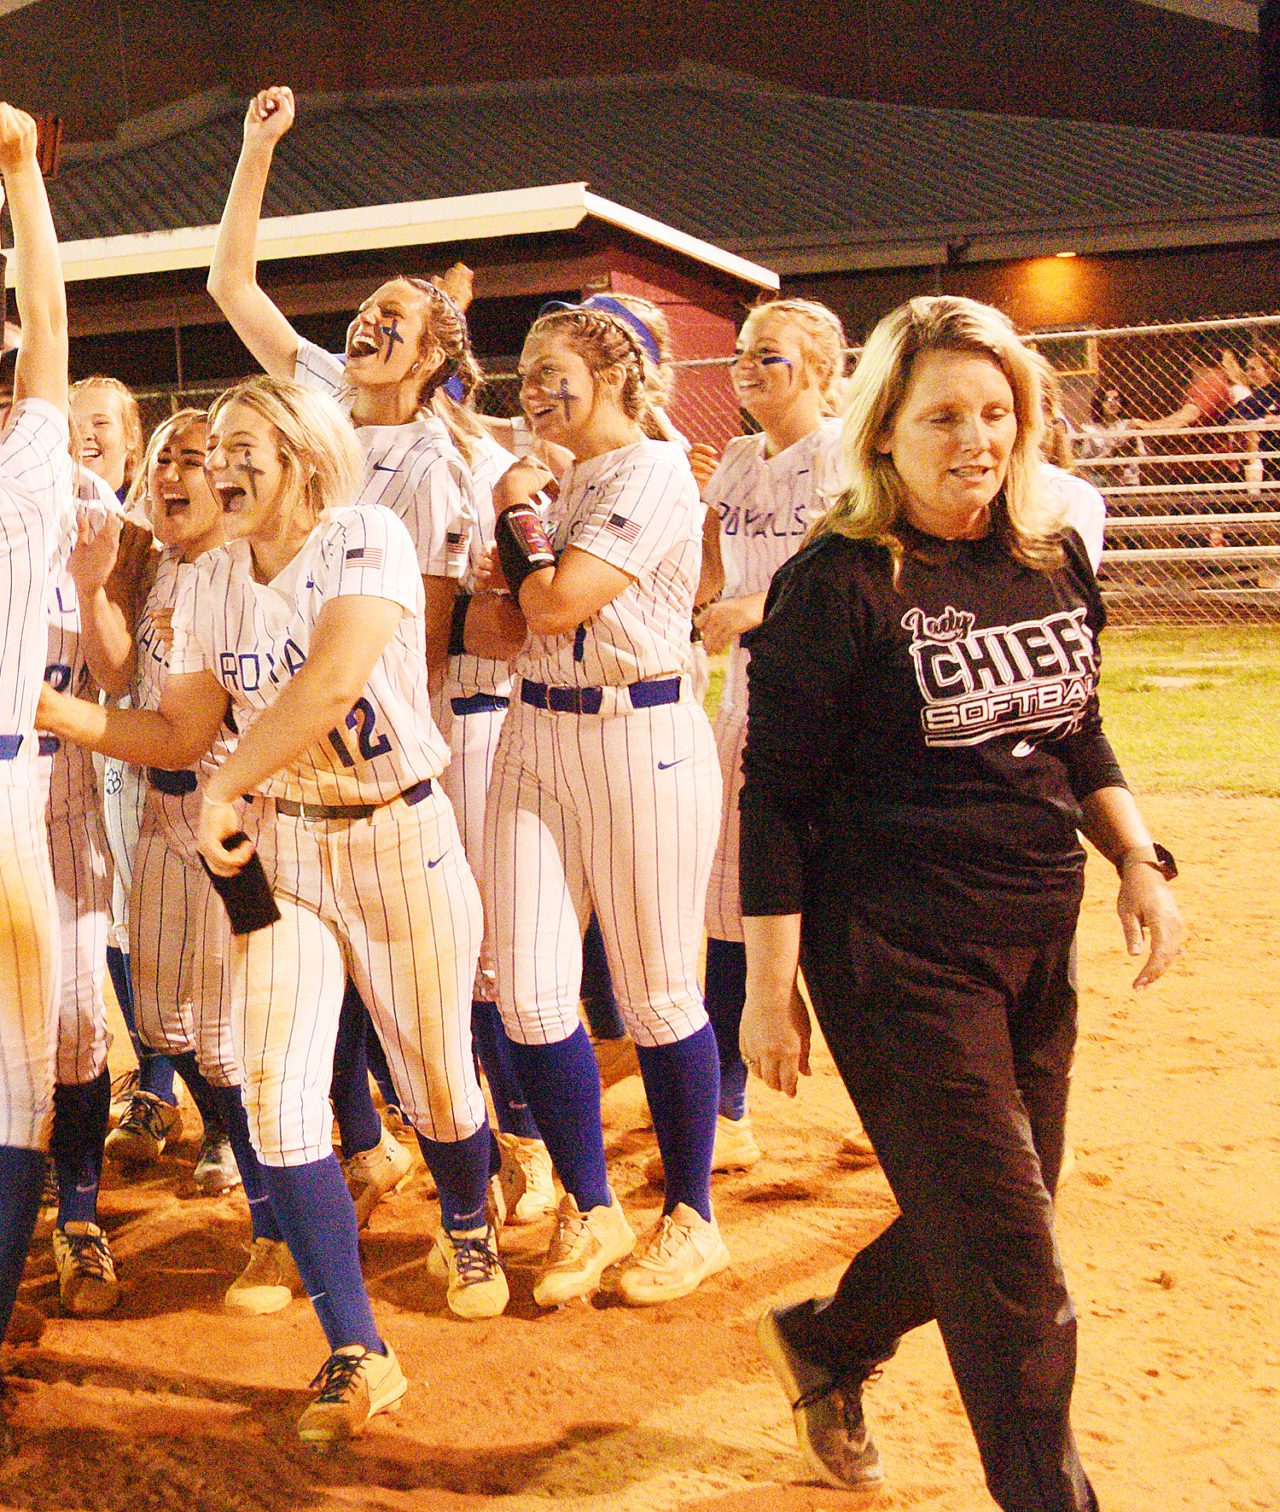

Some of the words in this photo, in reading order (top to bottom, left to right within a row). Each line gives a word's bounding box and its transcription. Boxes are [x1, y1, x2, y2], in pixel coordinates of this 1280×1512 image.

[901, 606, 976, 643] Lady
[220, 638, 307, 691] ROYA
[328, 696, 392, 768] 12
